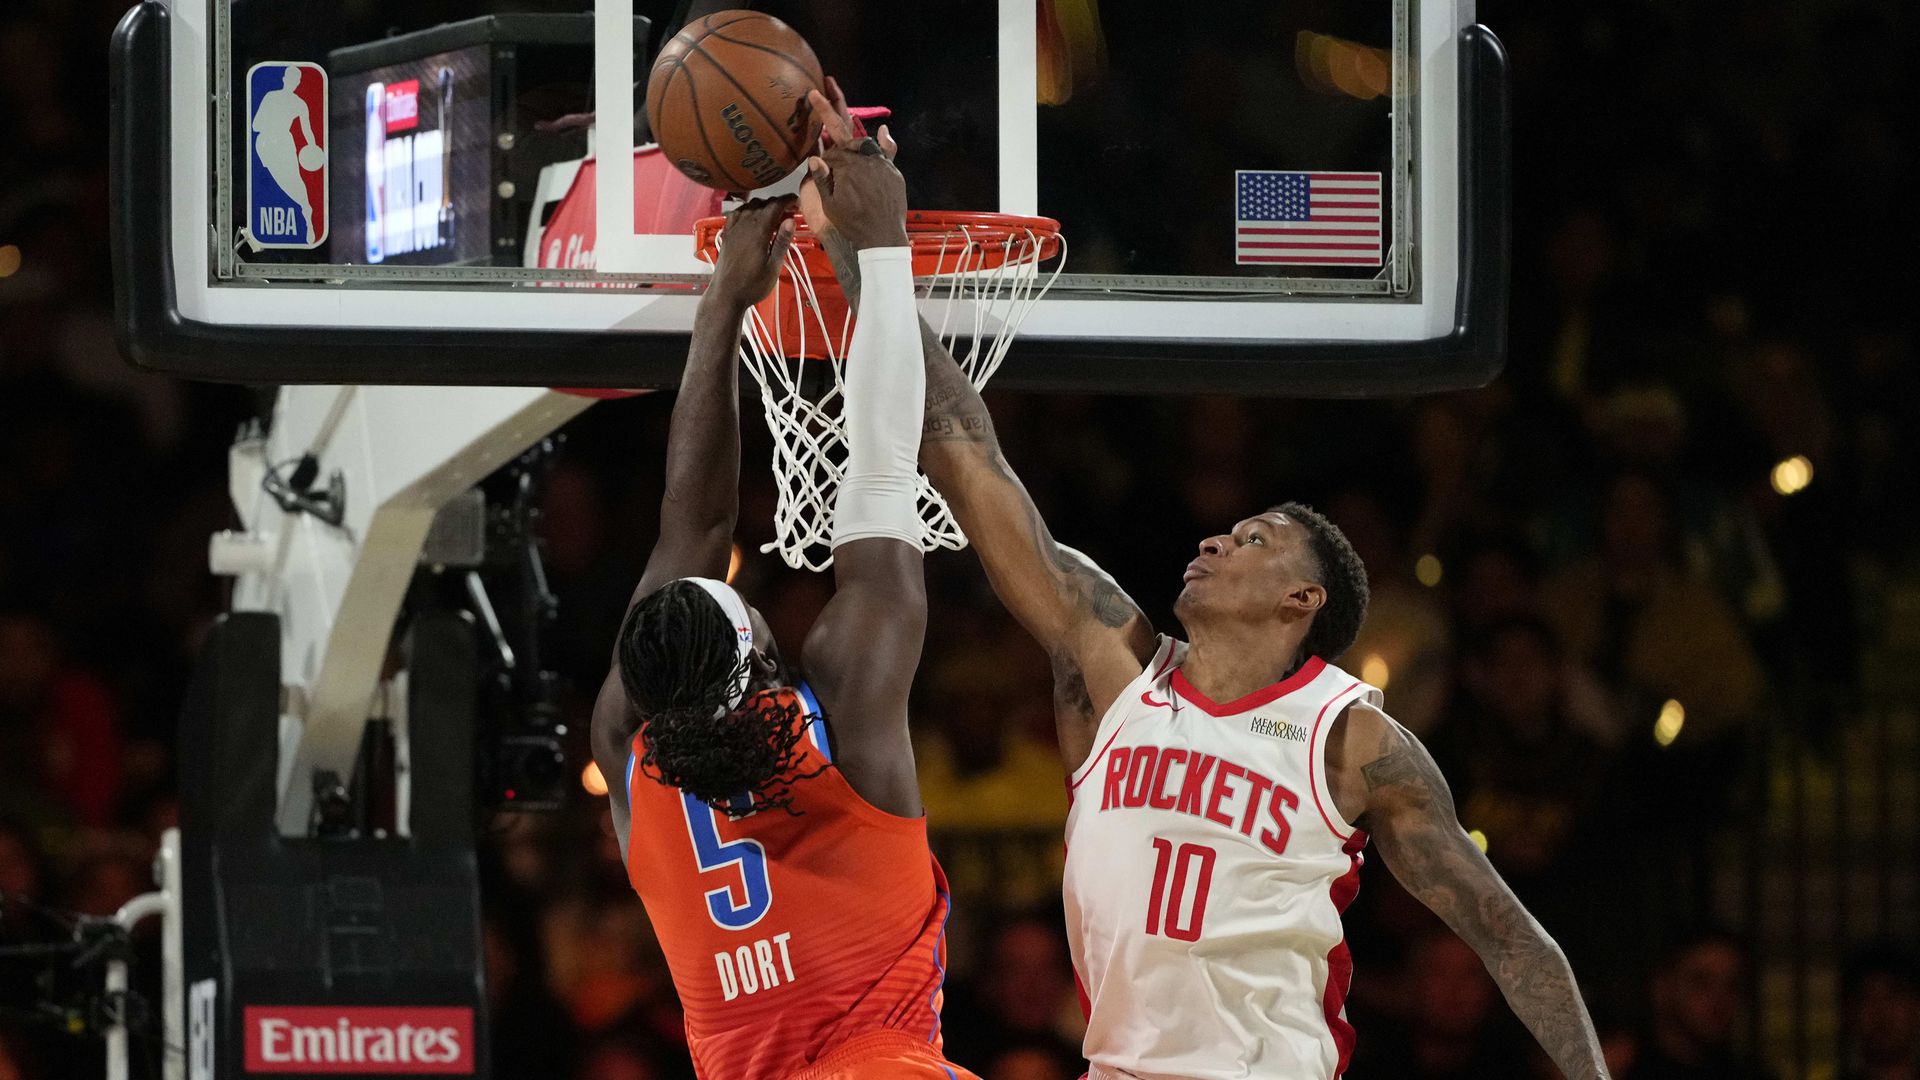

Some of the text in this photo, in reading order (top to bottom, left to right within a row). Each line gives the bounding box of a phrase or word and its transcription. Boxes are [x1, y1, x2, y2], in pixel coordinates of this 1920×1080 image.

[720, 101, 786, 185] Wilson
[260, 206, 298, 236] NBA
[1250, 724, 1307, 743] HERMANN
[1251, 716, 1308, 737] MEMORIAL
[1100, 745, 1300, 855] ROCKETS
[678, 786, 773, 931] 5
[1145, 836, 1217, 943] 10
[714, 931, 796, 1002] DORT
[258, 1016, 461, 1063] Emirates
